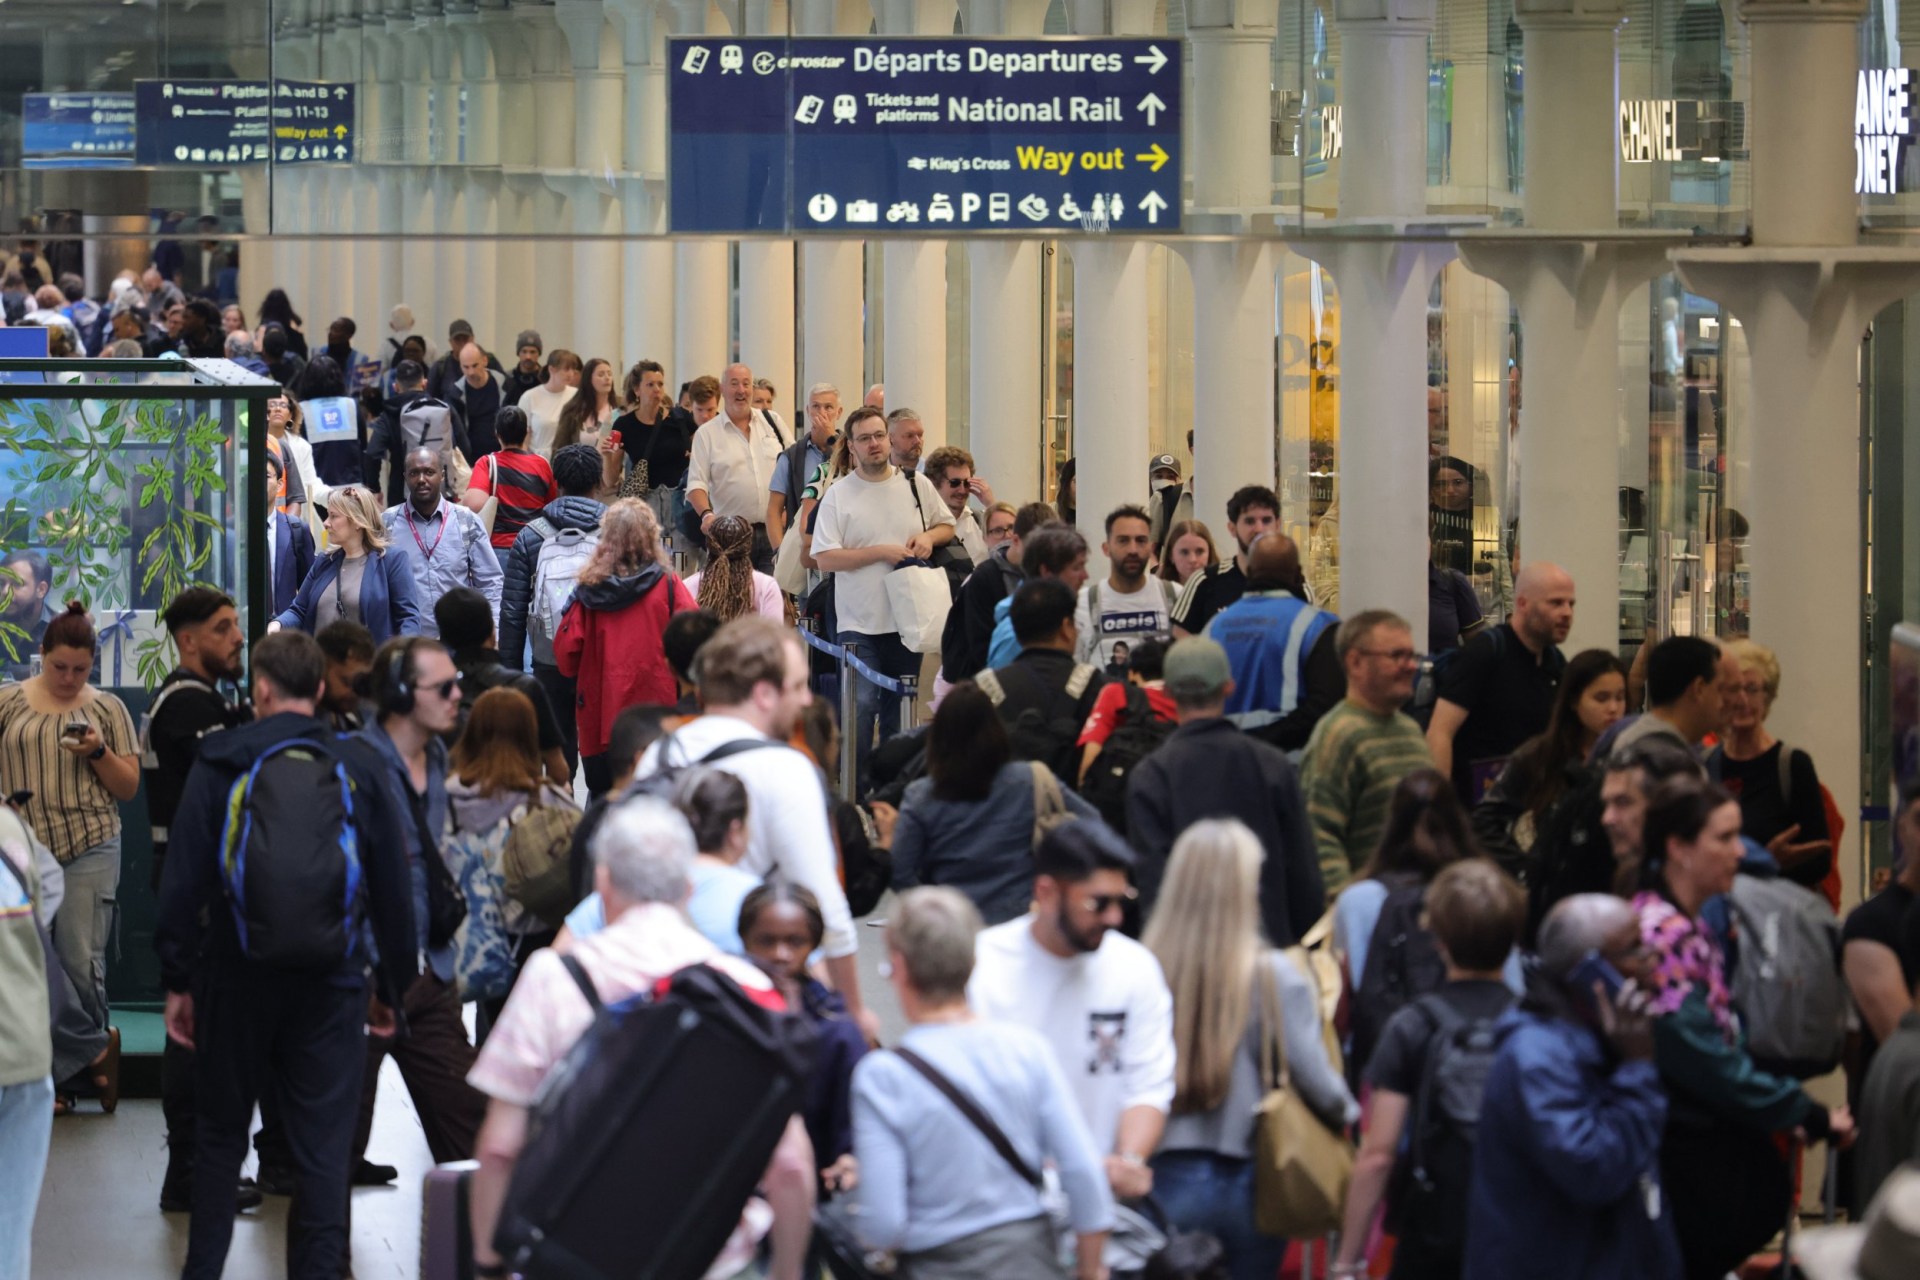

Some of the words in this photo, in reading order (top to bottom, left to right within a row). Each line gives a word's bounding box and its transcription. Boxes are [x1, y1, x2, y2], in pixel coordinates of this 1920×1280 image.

[853, 46, 961, 78] Départs
[968, 47, 1122, 78] Departures
[293, 88, 316, 98] and
[318, 88, 328, 98] B
[865, 93, 912, 106] Tickets
[914, 93, 939, 106] and
[296, 106, 328, 118] 11-13
[876, 110, 940, 124] platforms
[947, 96, 1062, 122] National
[1069, 96, 1122, 122] Rail
[308, 127, 328, 138] out
[1619, 99, 1682, 162] CHANEL
[929, 157, 971, 173] King's
[972, 158, 1011, 171] Cross
[1015, 145, 1074, 176] Way
[1080, 147, 1124, 170] out
[1104, 614, 1155, 630] oasis
